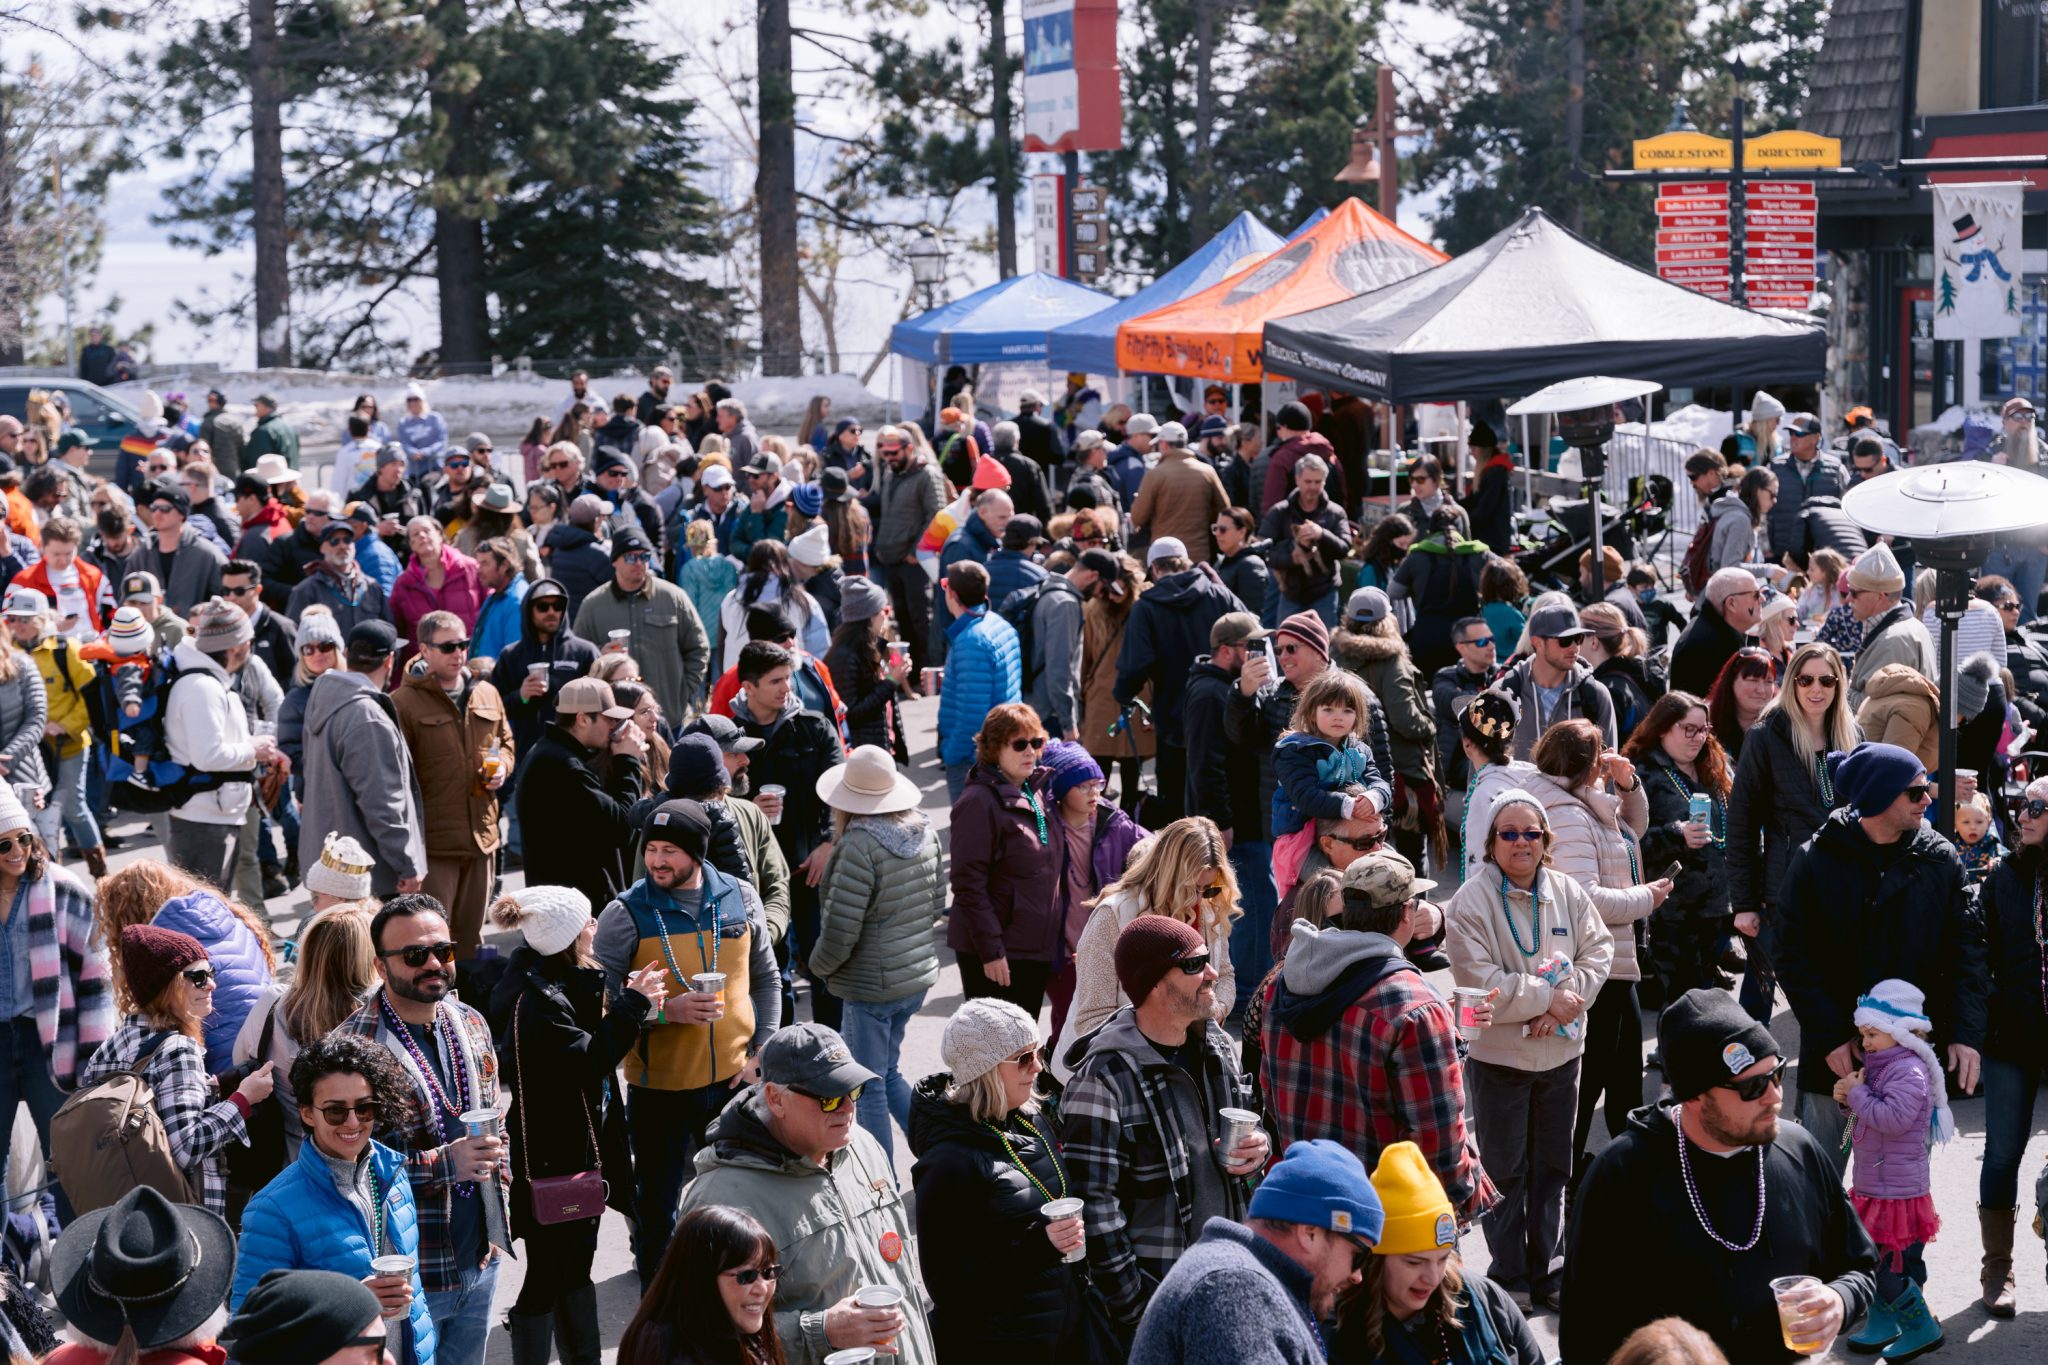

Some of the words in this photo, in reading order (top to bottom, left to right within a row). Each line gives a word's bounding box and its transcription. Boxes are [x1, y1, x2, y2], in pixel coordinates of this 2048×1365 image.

[1639, 148, 1728, 160] COBBLESTONE
[1757, 147, 1827, 158] DIRECTORY
[1341, 362, 1388, 387] COMPANY
